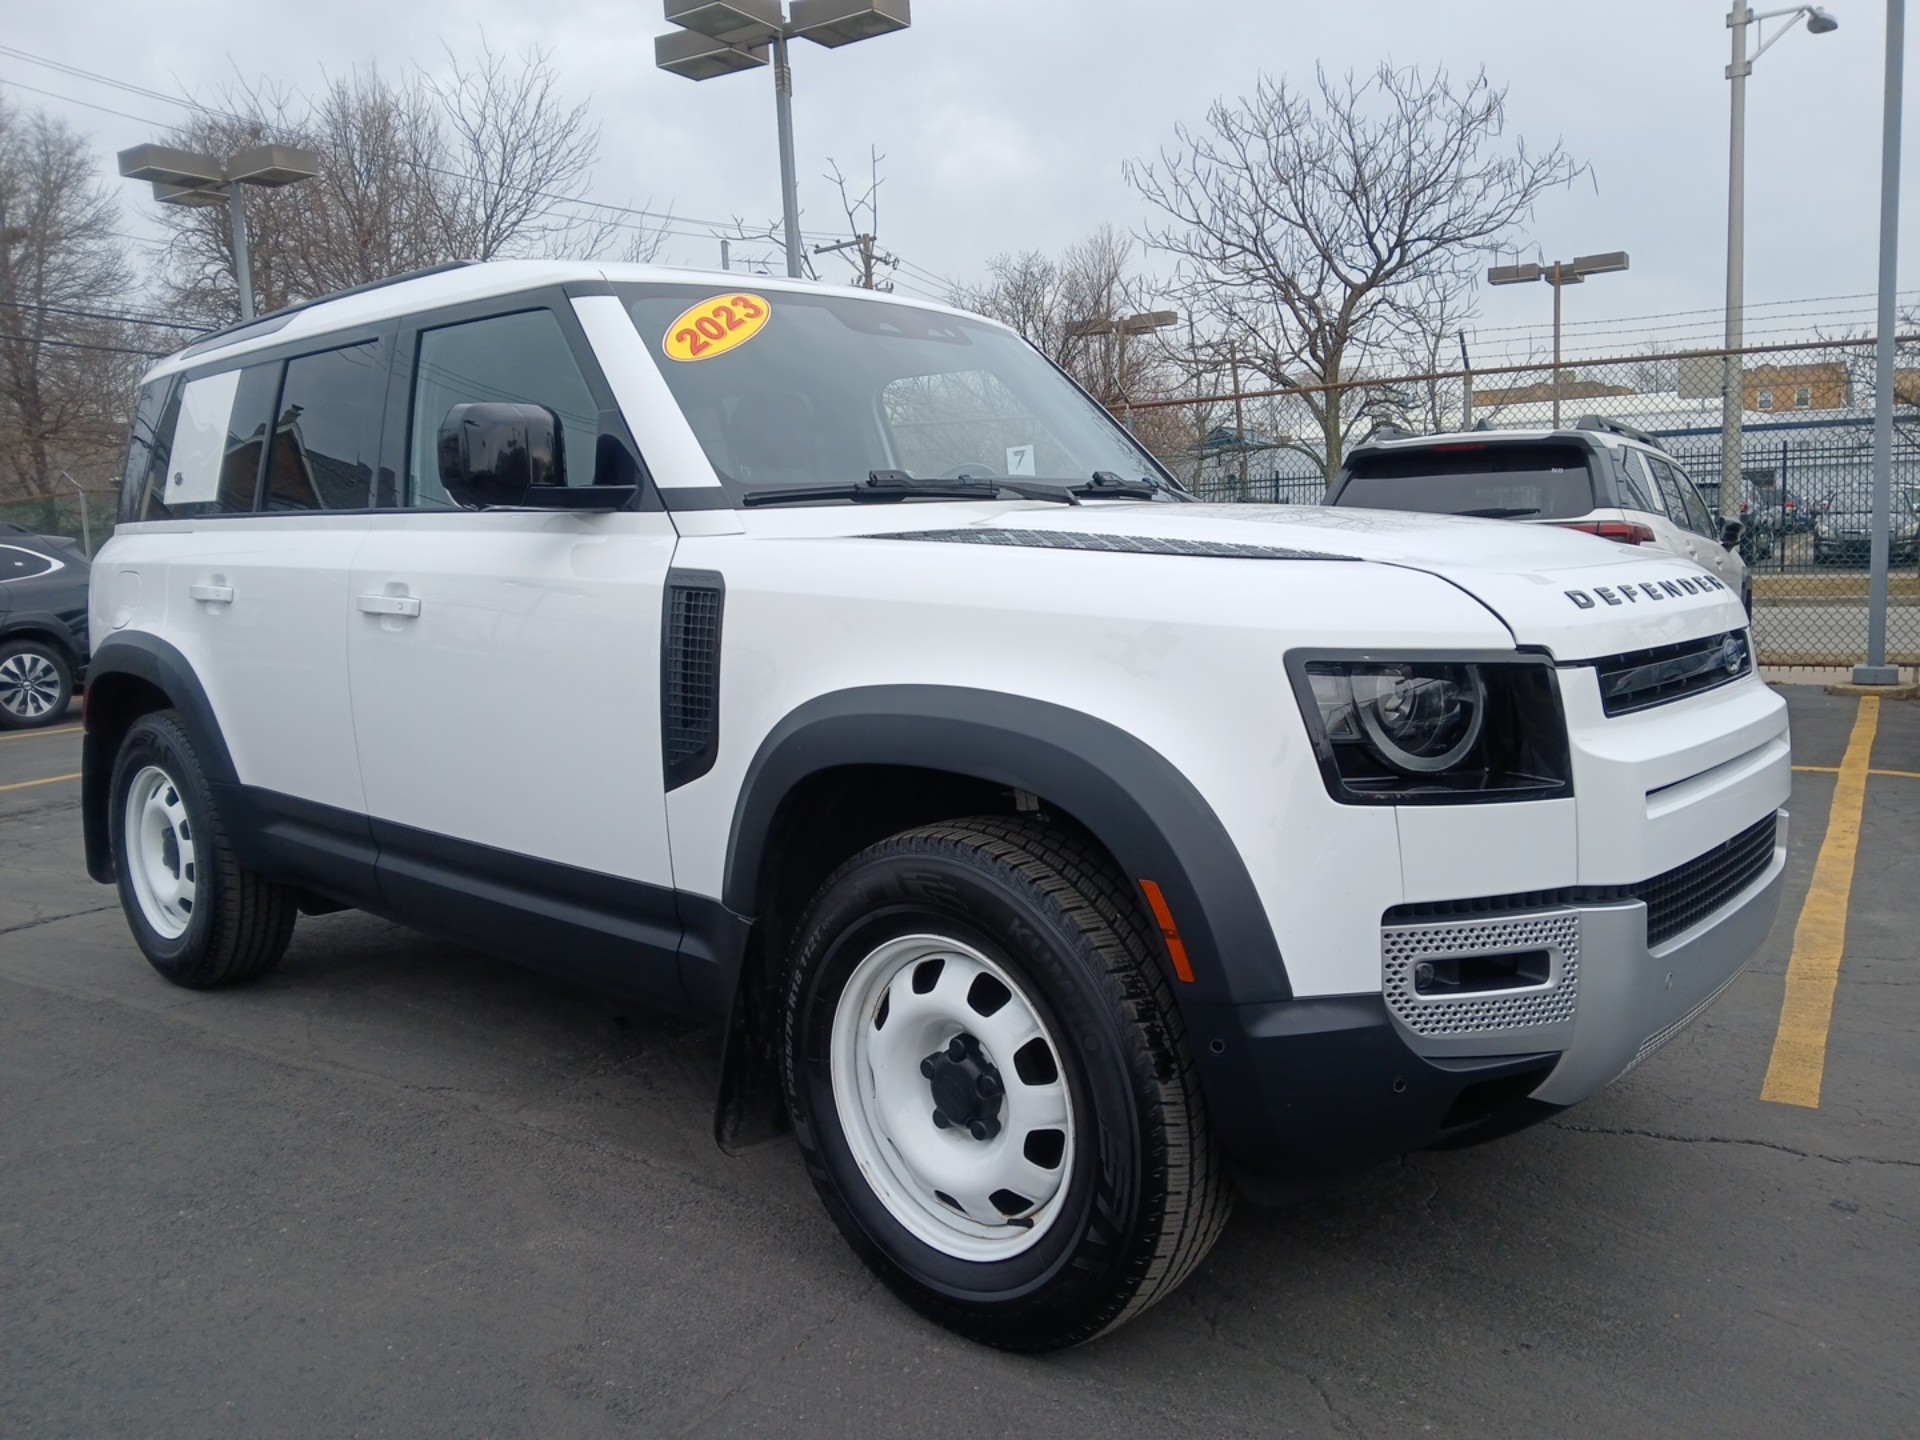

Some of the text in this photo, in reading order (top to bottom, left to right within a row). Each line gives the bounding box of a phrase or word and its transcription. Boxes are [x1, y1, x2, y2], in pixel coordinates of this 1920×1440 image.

[676, 296, 763, 356] 2023
[1013, 449, 1026, 471] 7
[1563, 574, 1725, 610] DEFENDER
